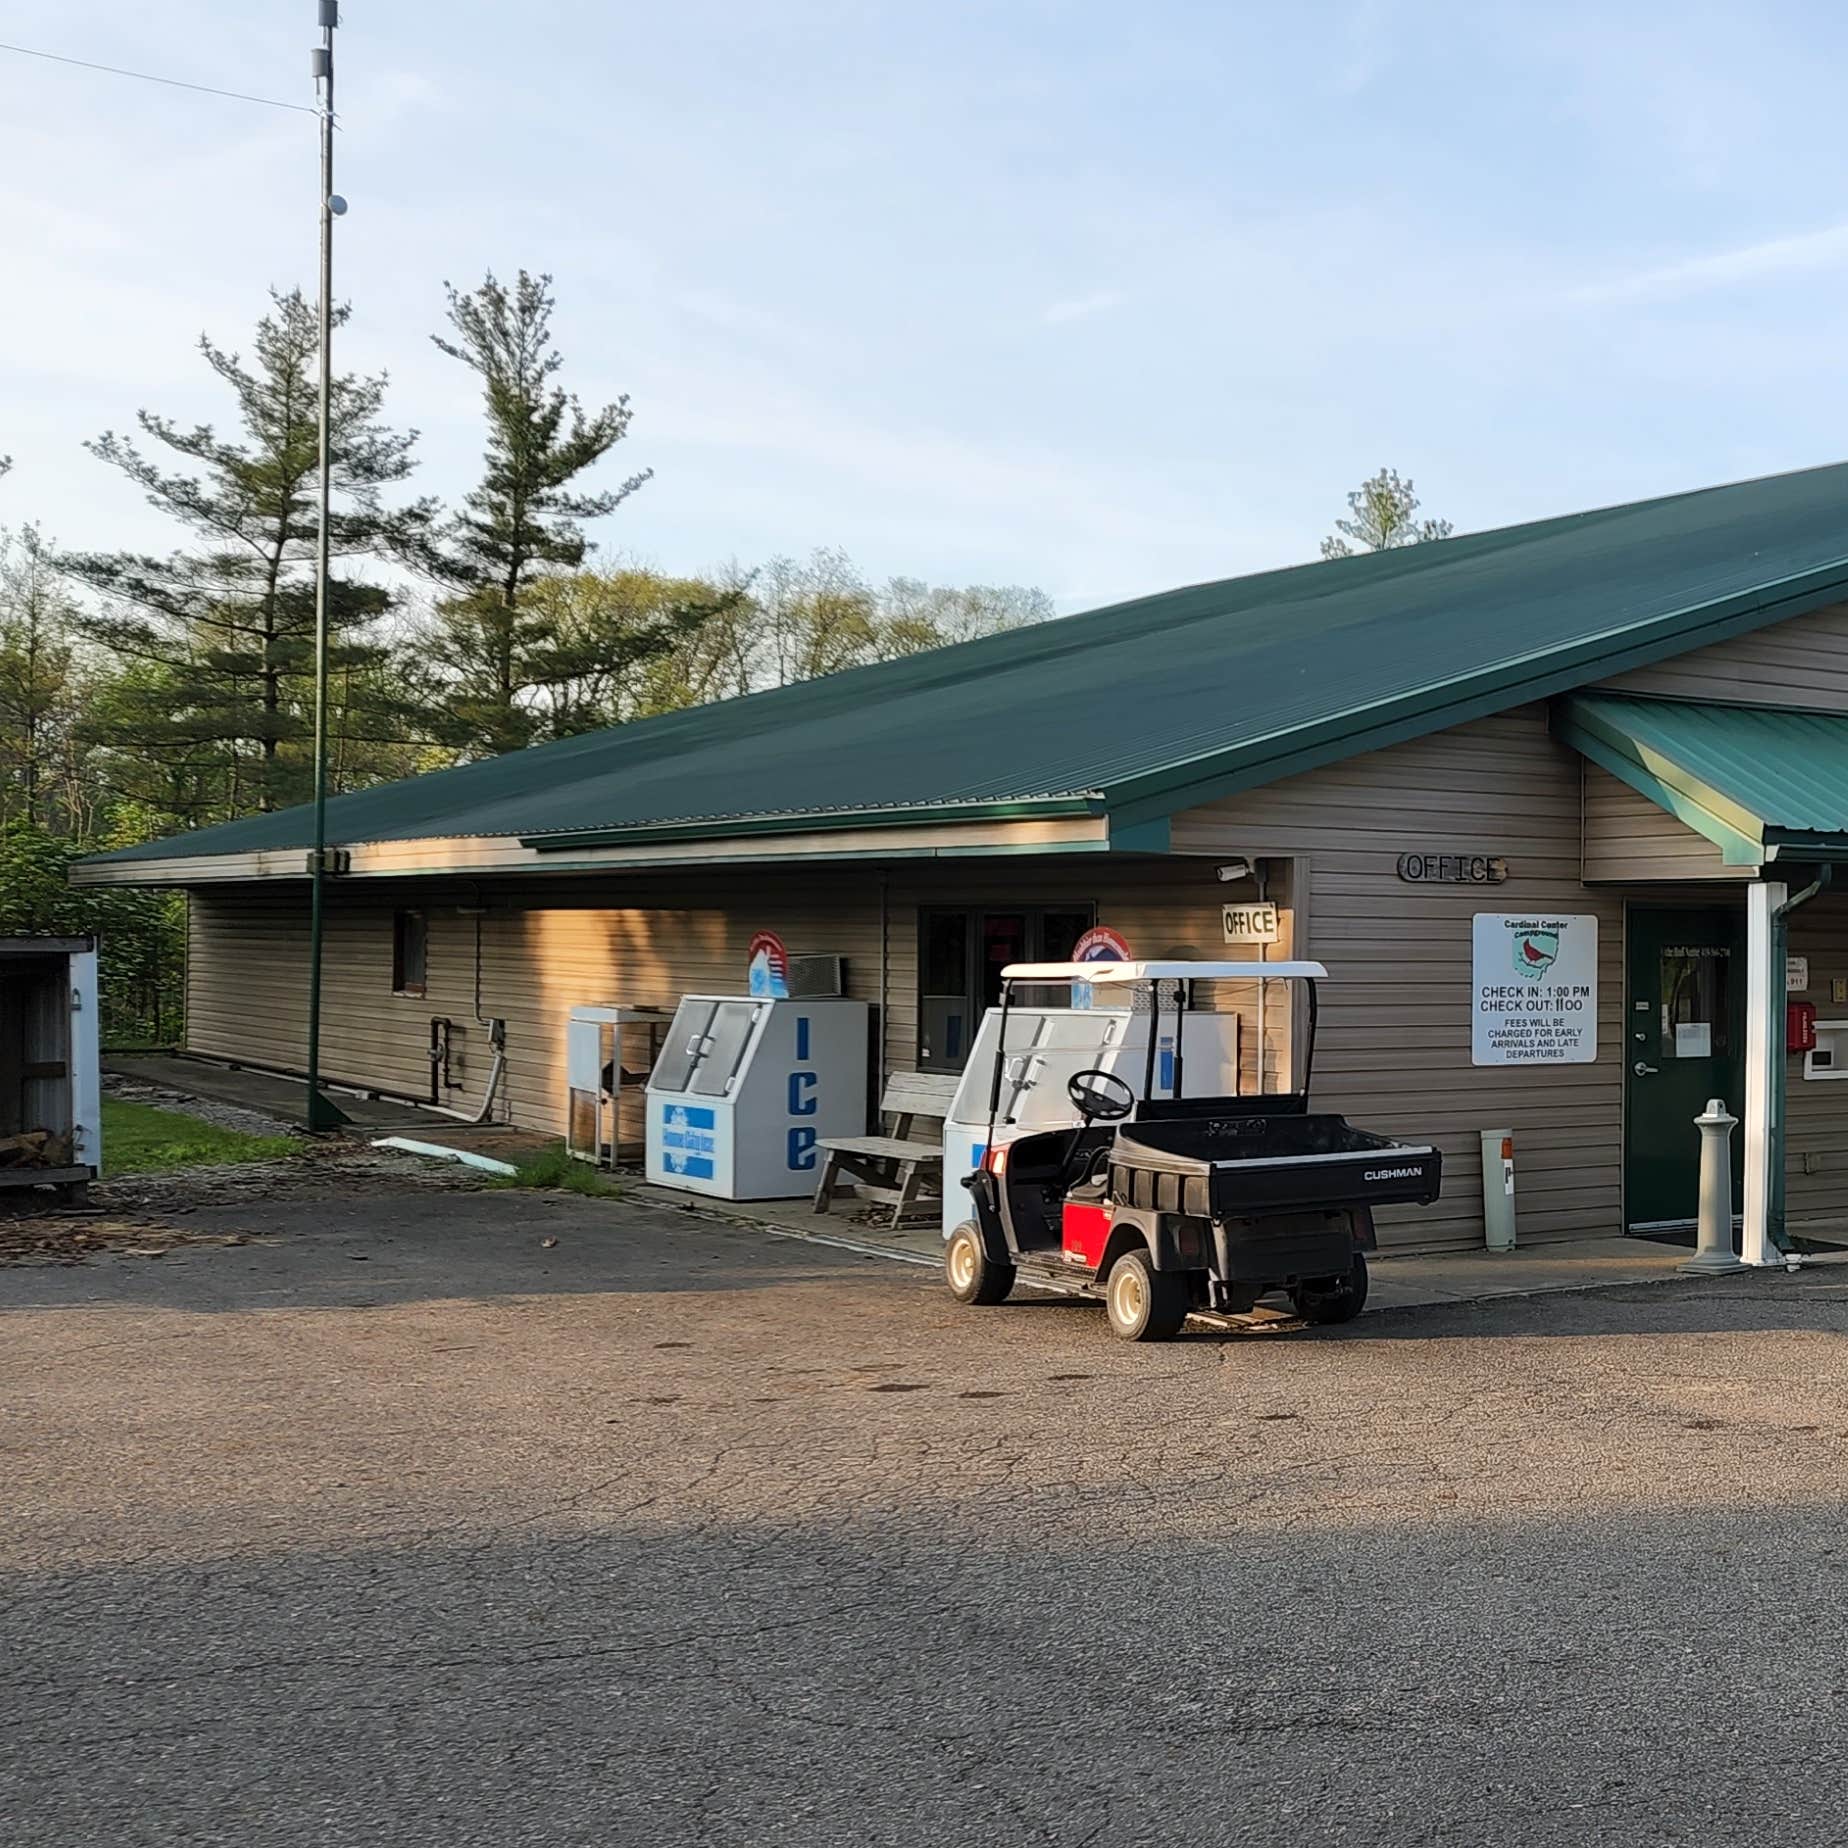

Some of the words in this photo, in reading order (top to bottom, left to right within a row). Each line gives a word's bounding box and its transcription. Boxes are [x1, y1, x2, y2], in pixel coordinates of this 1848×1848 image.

[1406, 855, 1501, 882] OFFICE
[1226, 910, 1274, 935] OFFICE
[1504, 919, 1540, 929] Cardinal
[1541, 920, 1568, 930] Center
[1482, 986, 1524, 998] CHECK
[1528, 986, 1543, 998] IN:
[1547, 986, 1570, 998] 1:00
[1573, 985, 1590, 998] PM
[1480, 1000, 1523, 1012] CHECK
[1526, 1000, 1554, 1012] OUT:
[1505, 1019, 1528, 1028] FEES
[1529, 1018, 1551, 1027] WILL
[1553, 1018, 1565, 1027] BE
[1488, 1029, 1532, 1038] CHARGED
[1535, 1029, 1553, 1038] FOR
[1555, 1028, 1583, 1037] EARLY
[1491, 1040, 1535, 1049] ARRIVALS
[1537, 1039, 1556, 1048] AND
[1558, 1039, 1580, 1047] LATE
[1506, 1049, 1565, 1059] DEPARTURES
[1364, 1167, 1423, 1181] CUSHMAN
